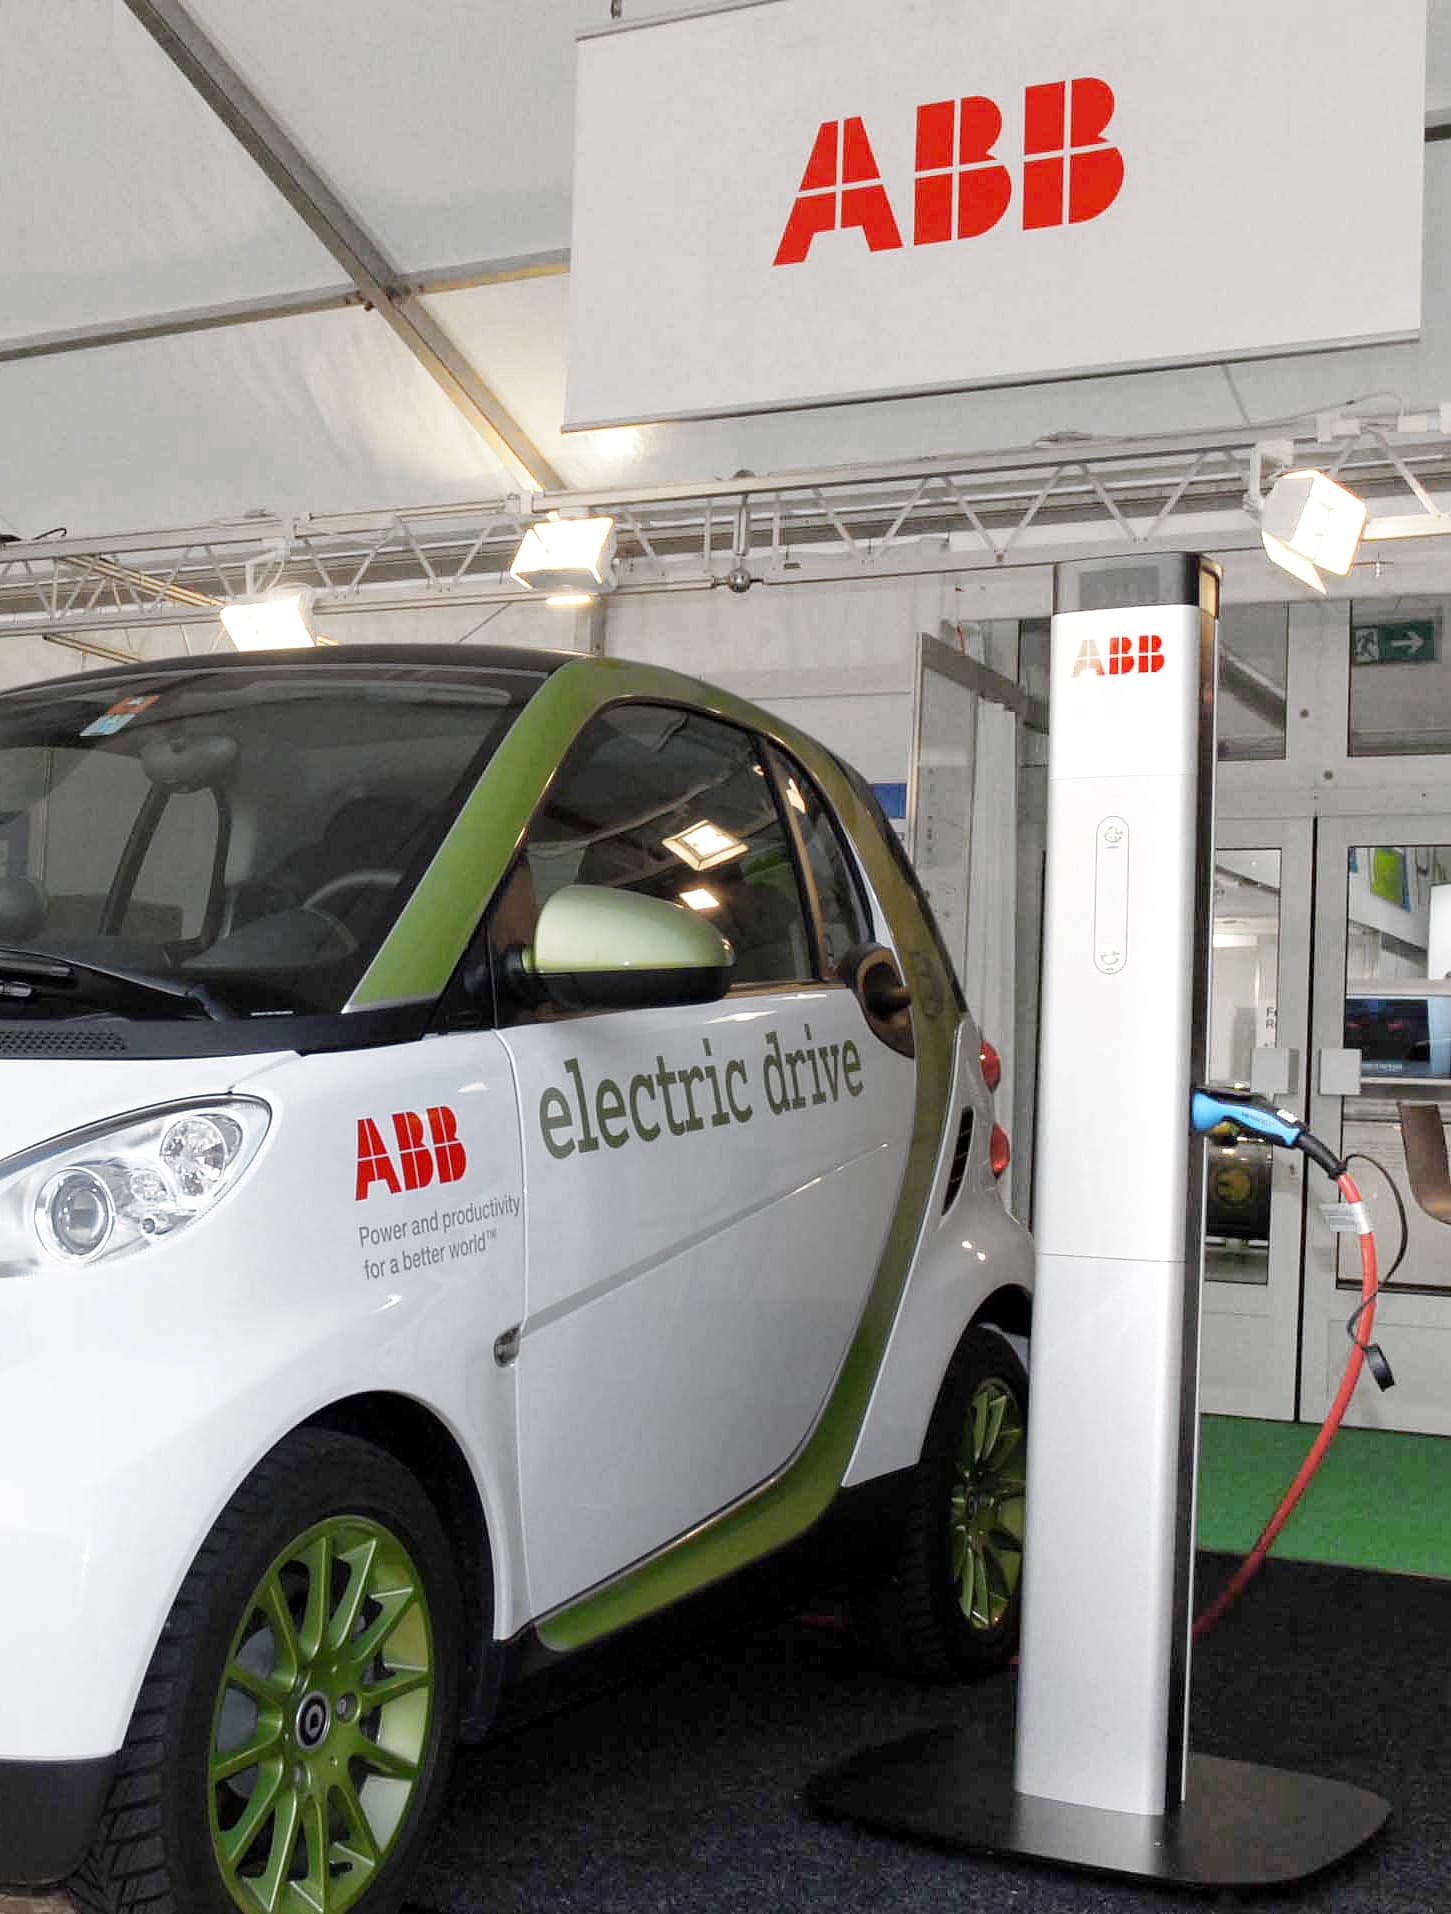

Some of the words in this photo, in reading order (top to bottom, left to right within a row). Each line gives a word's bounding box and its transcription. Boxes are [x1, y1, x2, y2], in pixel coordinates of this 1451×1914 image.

[773, 76, 1125, 267] ABB
[1071, 634, 1166, 677] ABB
[538, 1038, 753, 1160] electric
[762, 1024, 865, 1116] drive
[356, 1106, 467, 1201] ABB
[358, 1221, 409, 1249] Power
[411, 1209, 439, 1237] and
[441, 1193, 521, 1235] productivity
[363, 1258, 387, 1281] for
[389, 1257, 401, 1275] a
[401, 1244, 446, 1271] better
